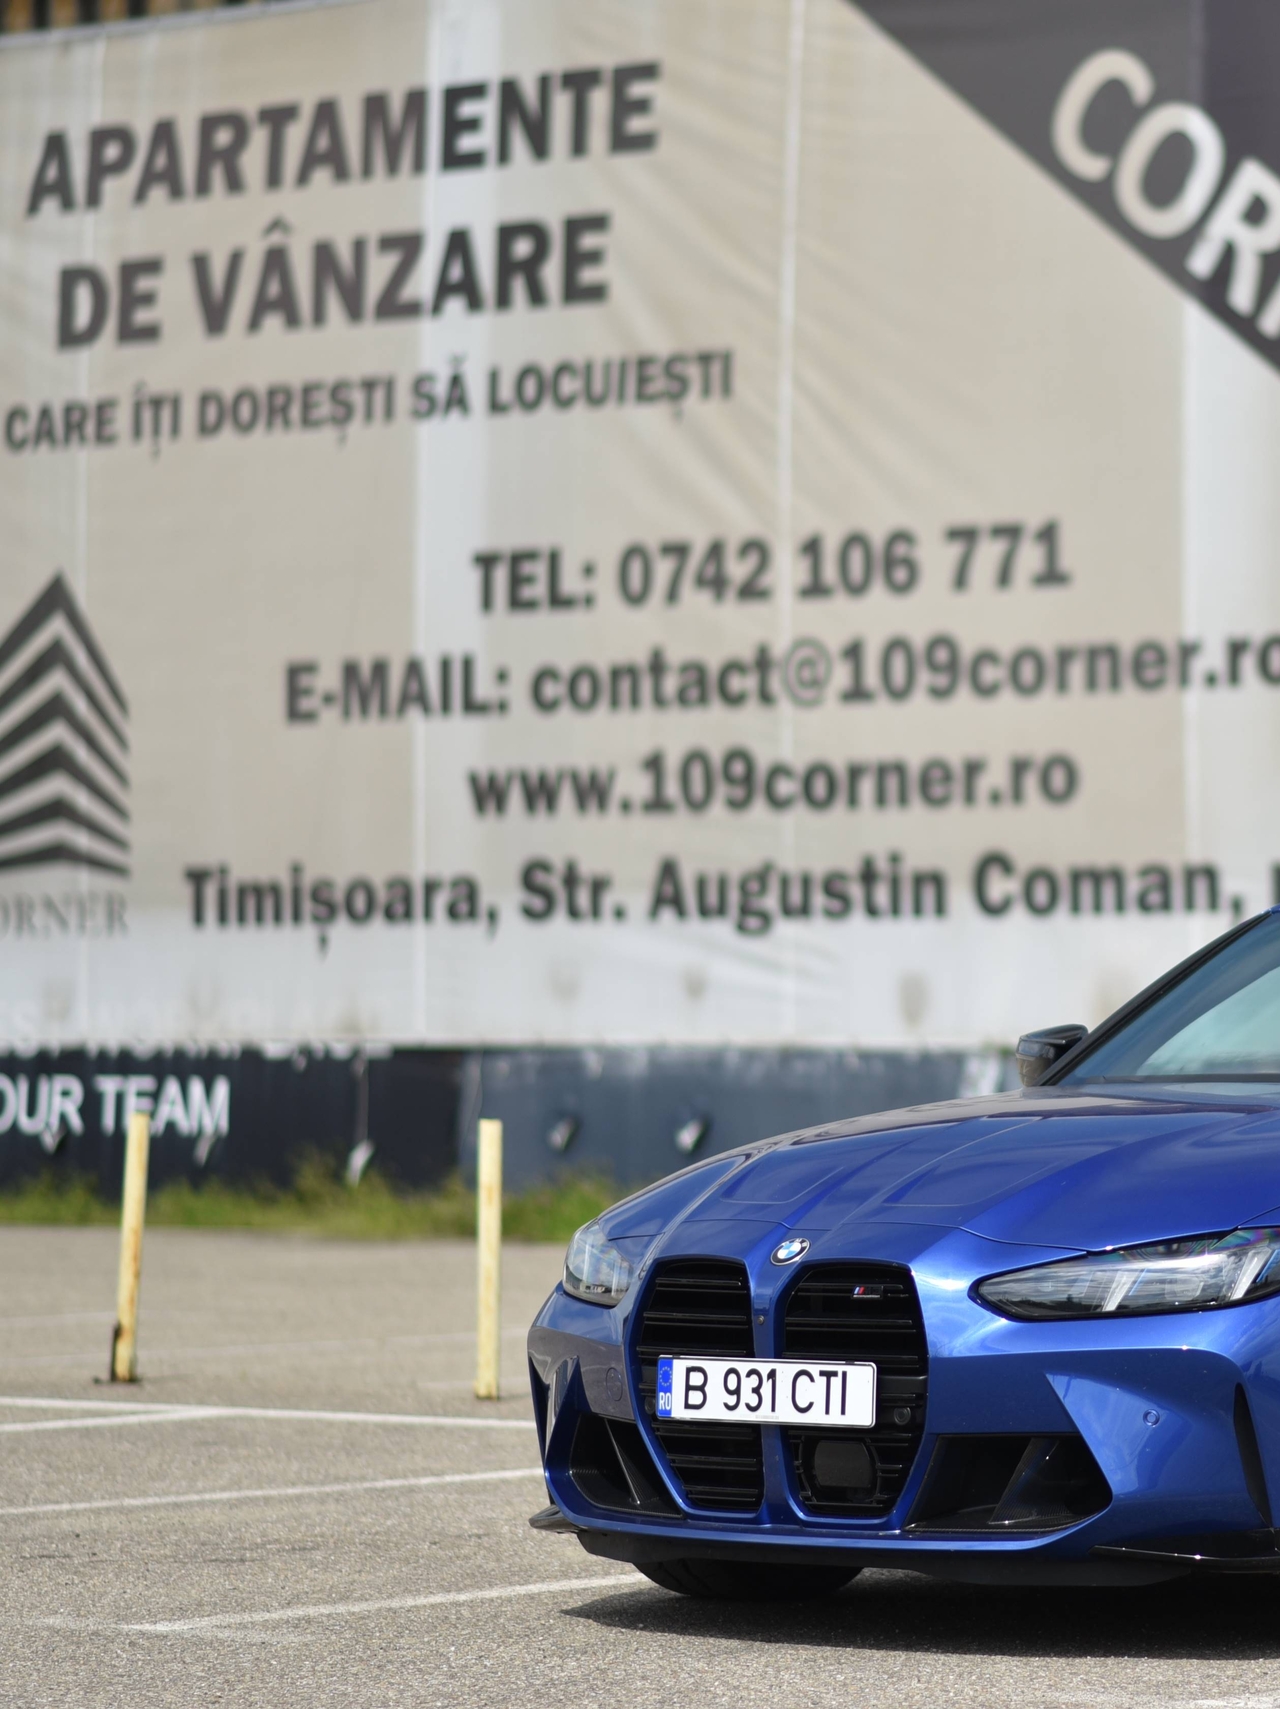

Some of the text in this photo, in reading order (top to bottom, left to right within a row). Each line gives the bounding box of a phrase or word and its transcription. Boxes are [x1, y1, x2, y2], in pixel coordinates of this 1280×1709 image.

[26, 62, 661, 218] APARTAMENTE
[56, 214, 611, 351] DE VÂNZARE
[3, 399, 118, 453] CARE
[410, 353, 470, 420] SĂ
[474, 521, 1072, 613] TEL: 0742 106 771
[285, 654, 511, 724] E-MAIL:
[467, 748, 1080, 817] www.109corner.ro
[520, 858, 626, 923] Str.
[648, 851, 949, 936] Augustin
[972, 850, 1246, 922] Coman,
[94, 1073, 231, 1136] TEAM
[658, 1391, 672, 1411] RO
[683, 1365, 848, 1416] B 931 CTI
